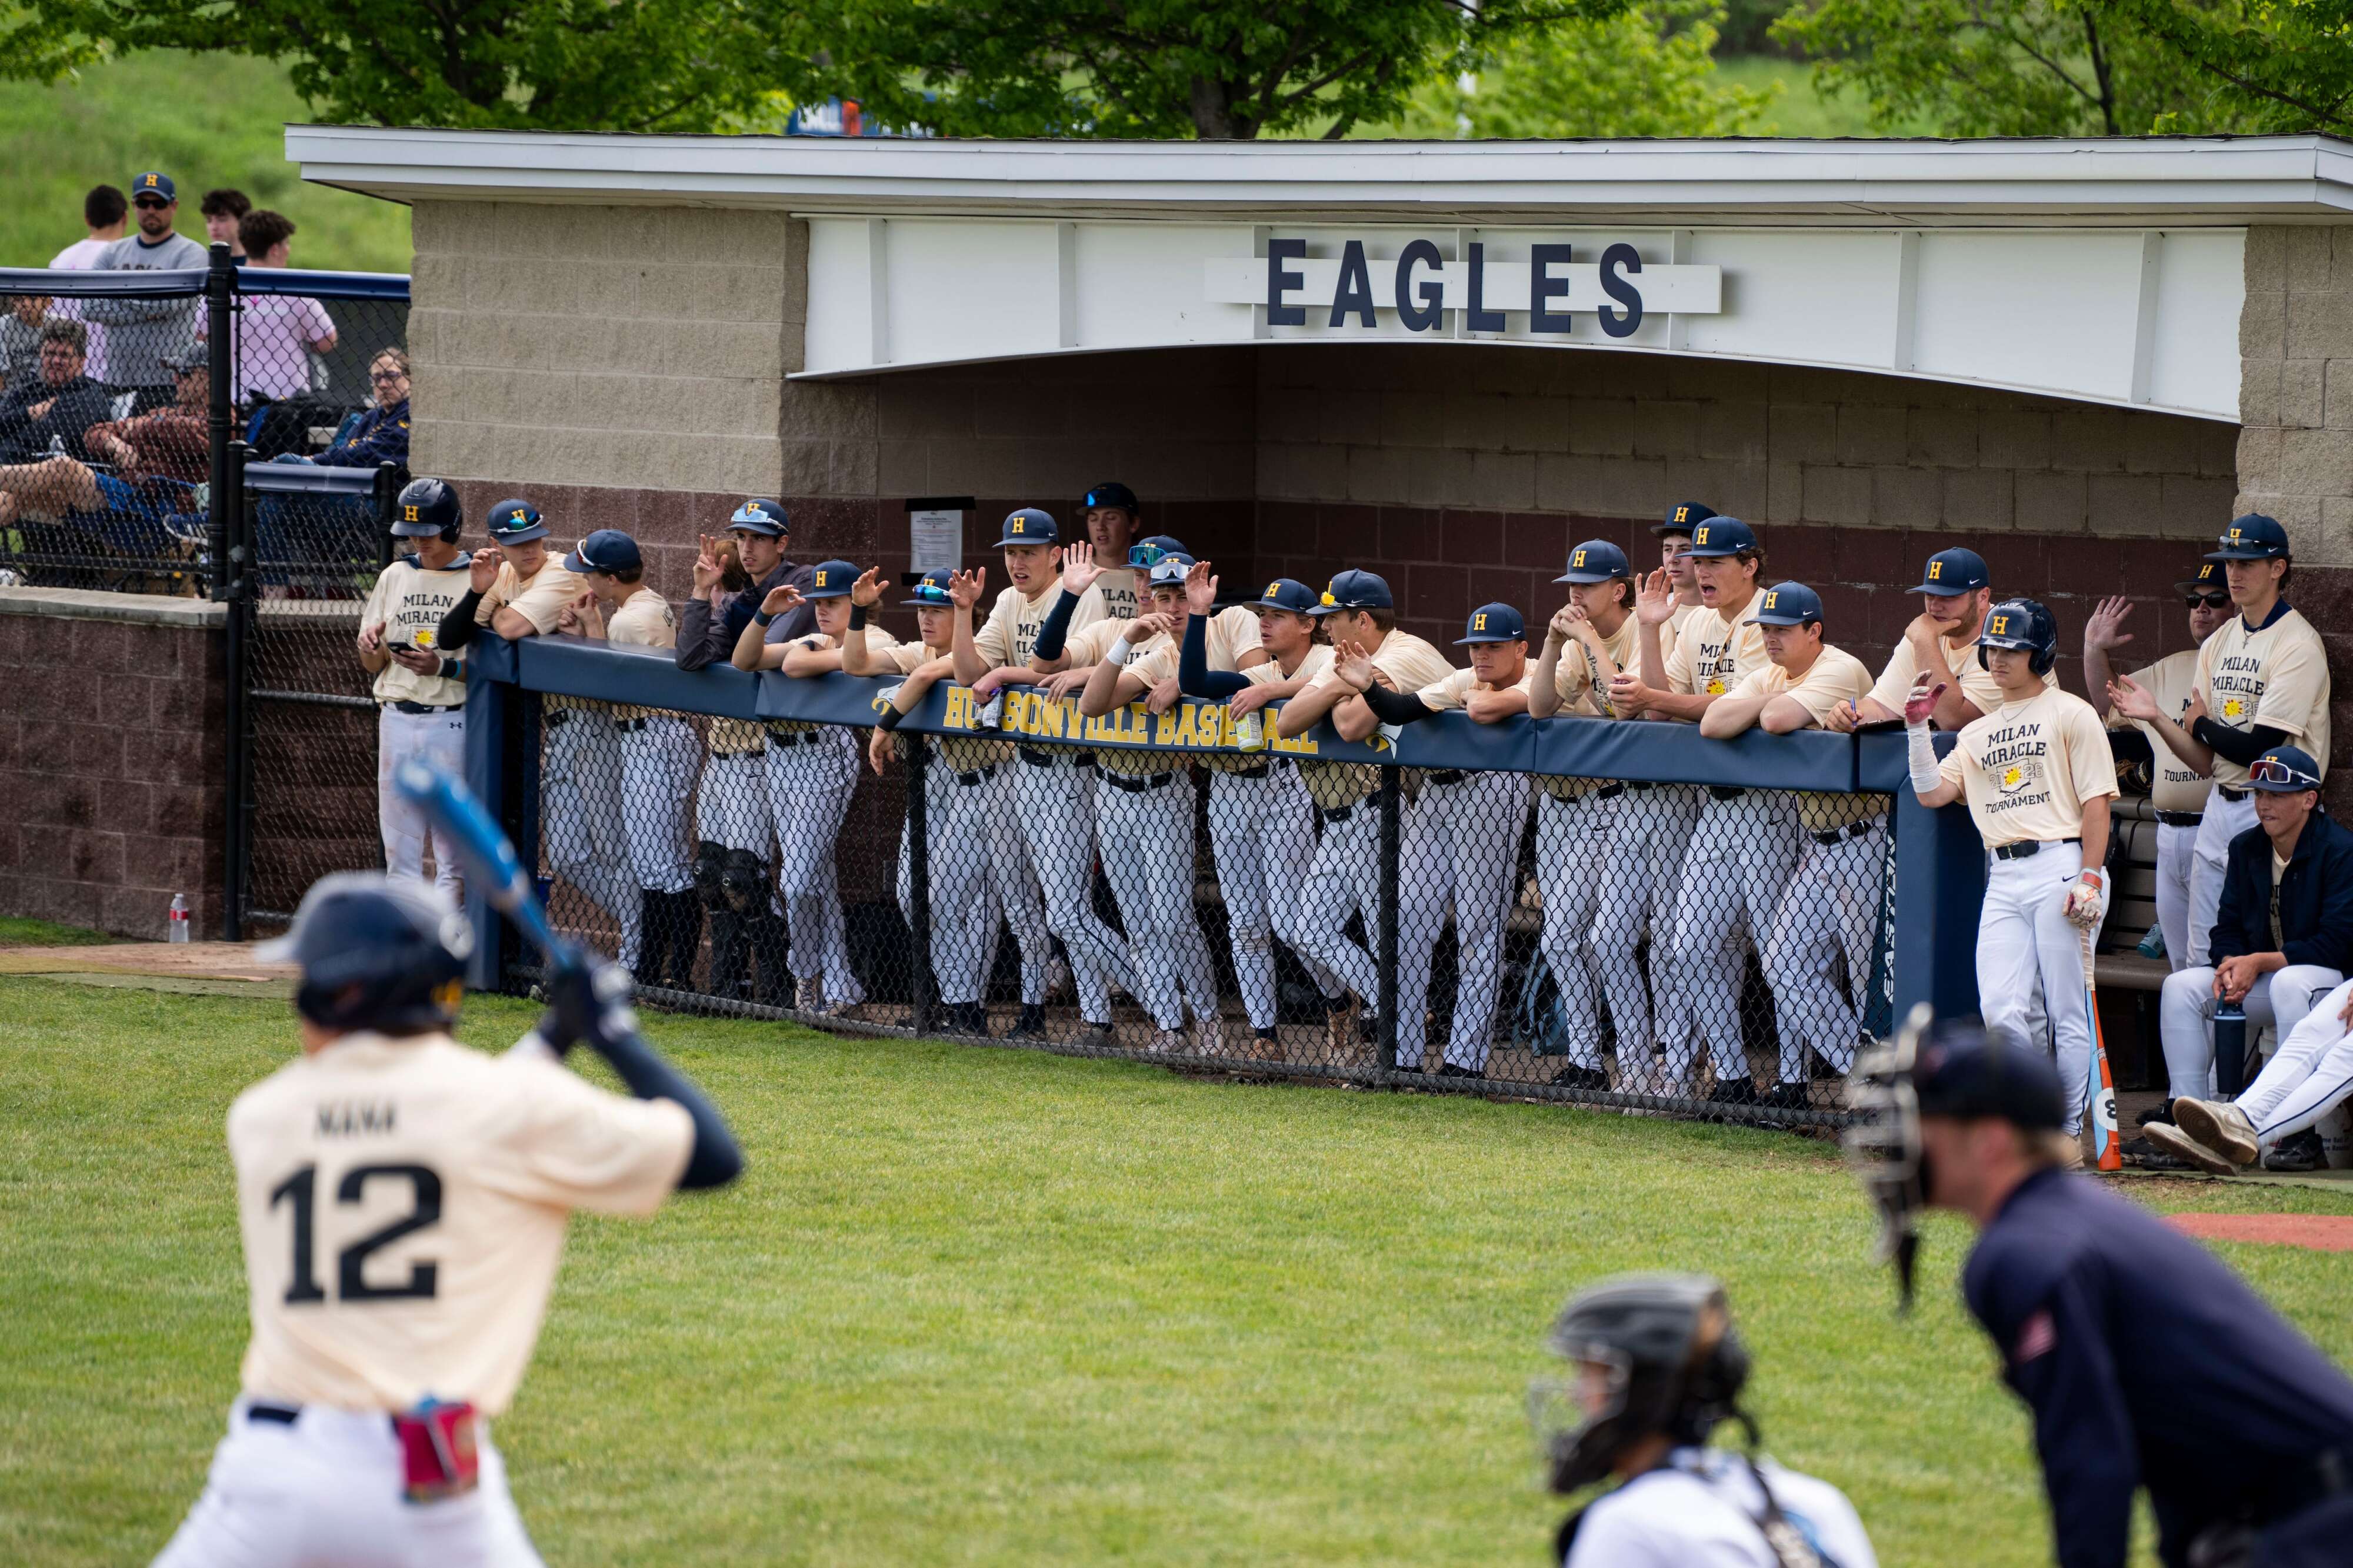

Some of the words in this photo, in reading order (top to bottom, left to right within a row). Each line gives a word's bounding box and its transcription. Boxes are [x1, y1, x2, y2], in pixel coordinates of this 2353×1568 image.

[146, 174, 159, 188] H
[1267, 238, 1643, 338] EAGLES
[404, 505, 419, 522] H
[1674, 507, 1689, 523] H
[1012, 516, 1025, 534] H
[1697, 528, 1709, 546] H
[1572, 550, 1587, 568] H
[815, 571, 828, 588] H
[1929, 561, 1943, 580] H
[2198, 563, 2215, 579] H
[1264, 583, 1281, 598] H
[403, 593, 454, 608] MILAN
[1764, 592, 1779, 609] H
[1474, 613, 1488, 631] H
[1991, 615, 2009, 636] H
[2221, 656, 2261, 673] MILAN
[2212, 676, 2265, 696] MIRACLE
[1988, 723, 2041, 748] MILAN
[1981, 742, 2047, 771] MIRACLE
[2022, 762, 2044, 780] 26
[1989, 772, 2004, 790] 20
[269, 1160, 444, 1306] 12
